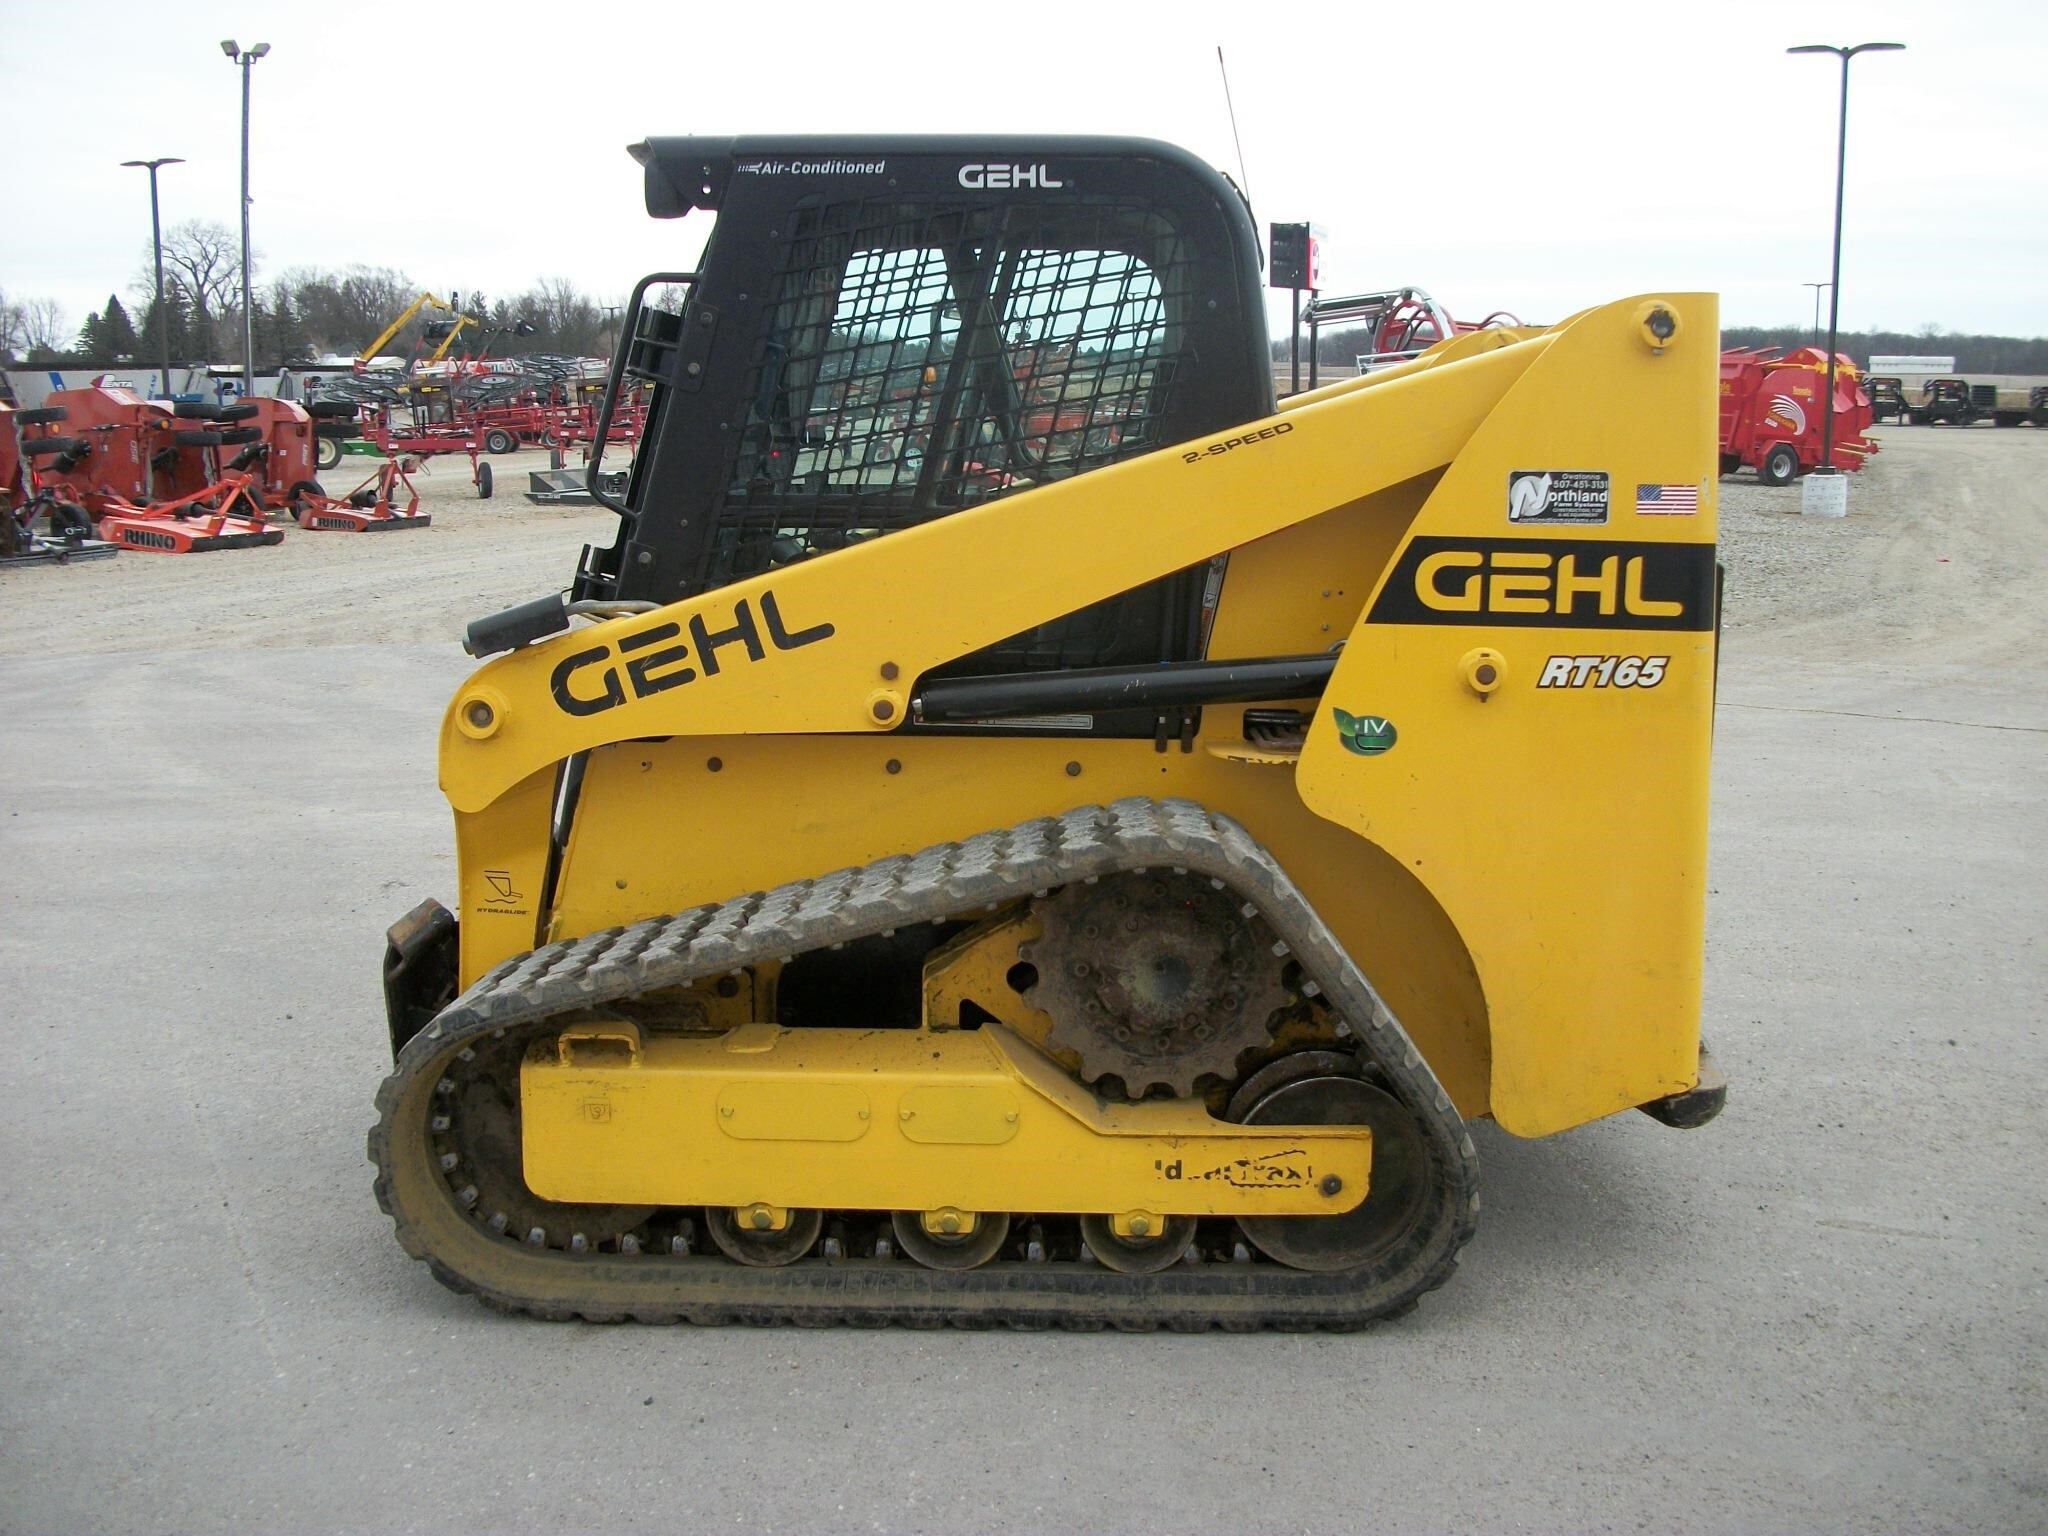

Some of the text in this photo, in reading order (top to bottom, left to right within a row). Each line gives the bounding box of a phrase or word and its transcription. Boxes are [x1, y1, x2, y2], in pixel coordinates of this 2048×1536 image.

[761, 160, 885, 175] Air-Conditioned
[957, 163, 1064, 189] GEHL
[1182, 422, 1294, 464] 2-SPEED
[316, 517, 357, 531] RHINO
[123, 528, 177, 551] RHINO
[1414, 550, 1684, 617] GEHL
[550, 589, 836, 717] GEHL
[1536, 655, 1671, 688] RT165
